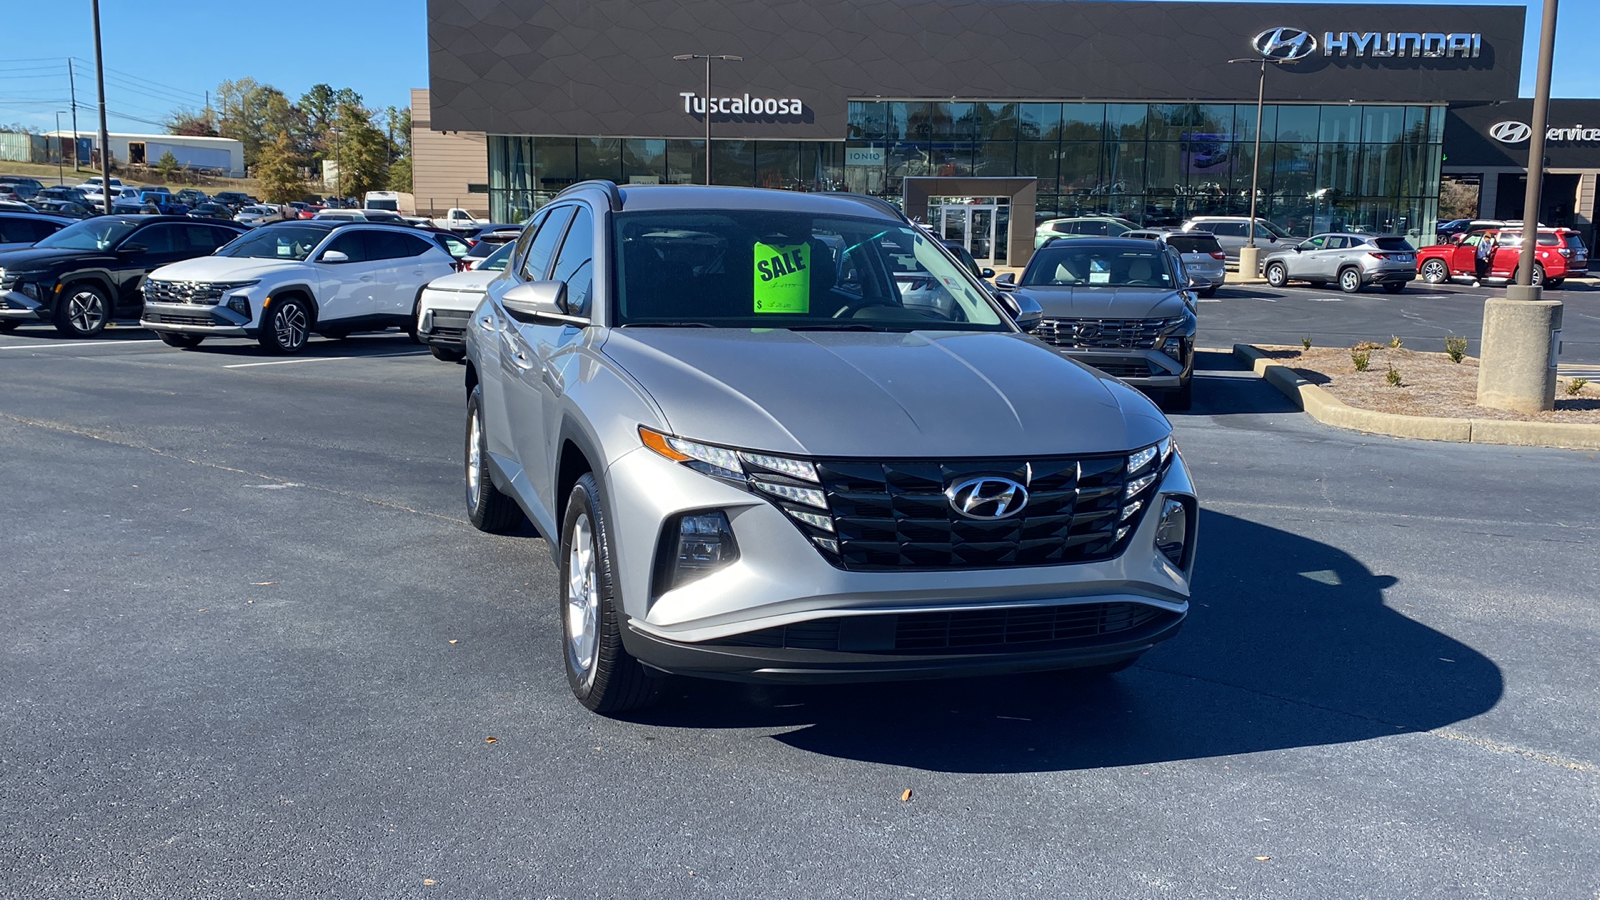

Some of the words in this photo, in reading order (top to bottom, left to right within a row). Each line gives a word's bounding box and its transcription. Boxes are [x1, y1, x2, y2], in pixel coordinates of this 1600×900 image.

[1324, 32, 1482, 58] HYUNDAI
[679, 92, 802, 115] Tuscaloosa
[1545, 124, 1600, 141] ervice
[757, 249, 806, 282] SALE
